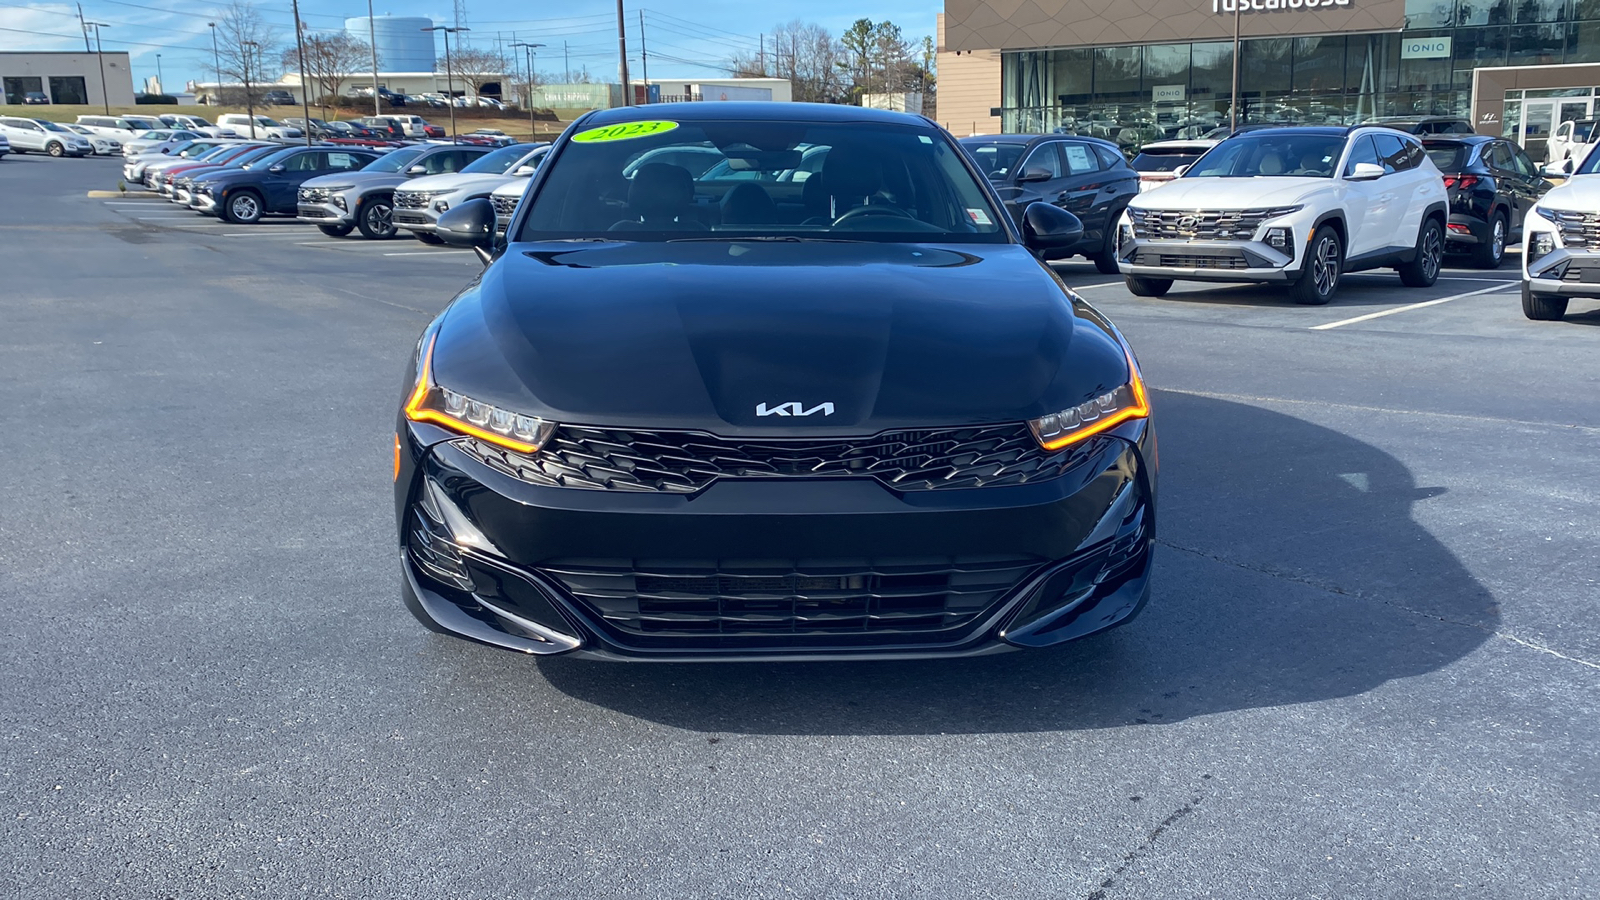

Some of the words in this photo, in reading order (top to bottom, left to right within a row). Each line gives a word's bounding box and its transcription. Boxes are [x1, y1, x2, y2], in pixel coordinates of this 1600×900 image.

[1407, 43, 1445, 53] IONIQ
[589, 122, 662, 140] 2023
[756, 402, 834, 416] KIA
